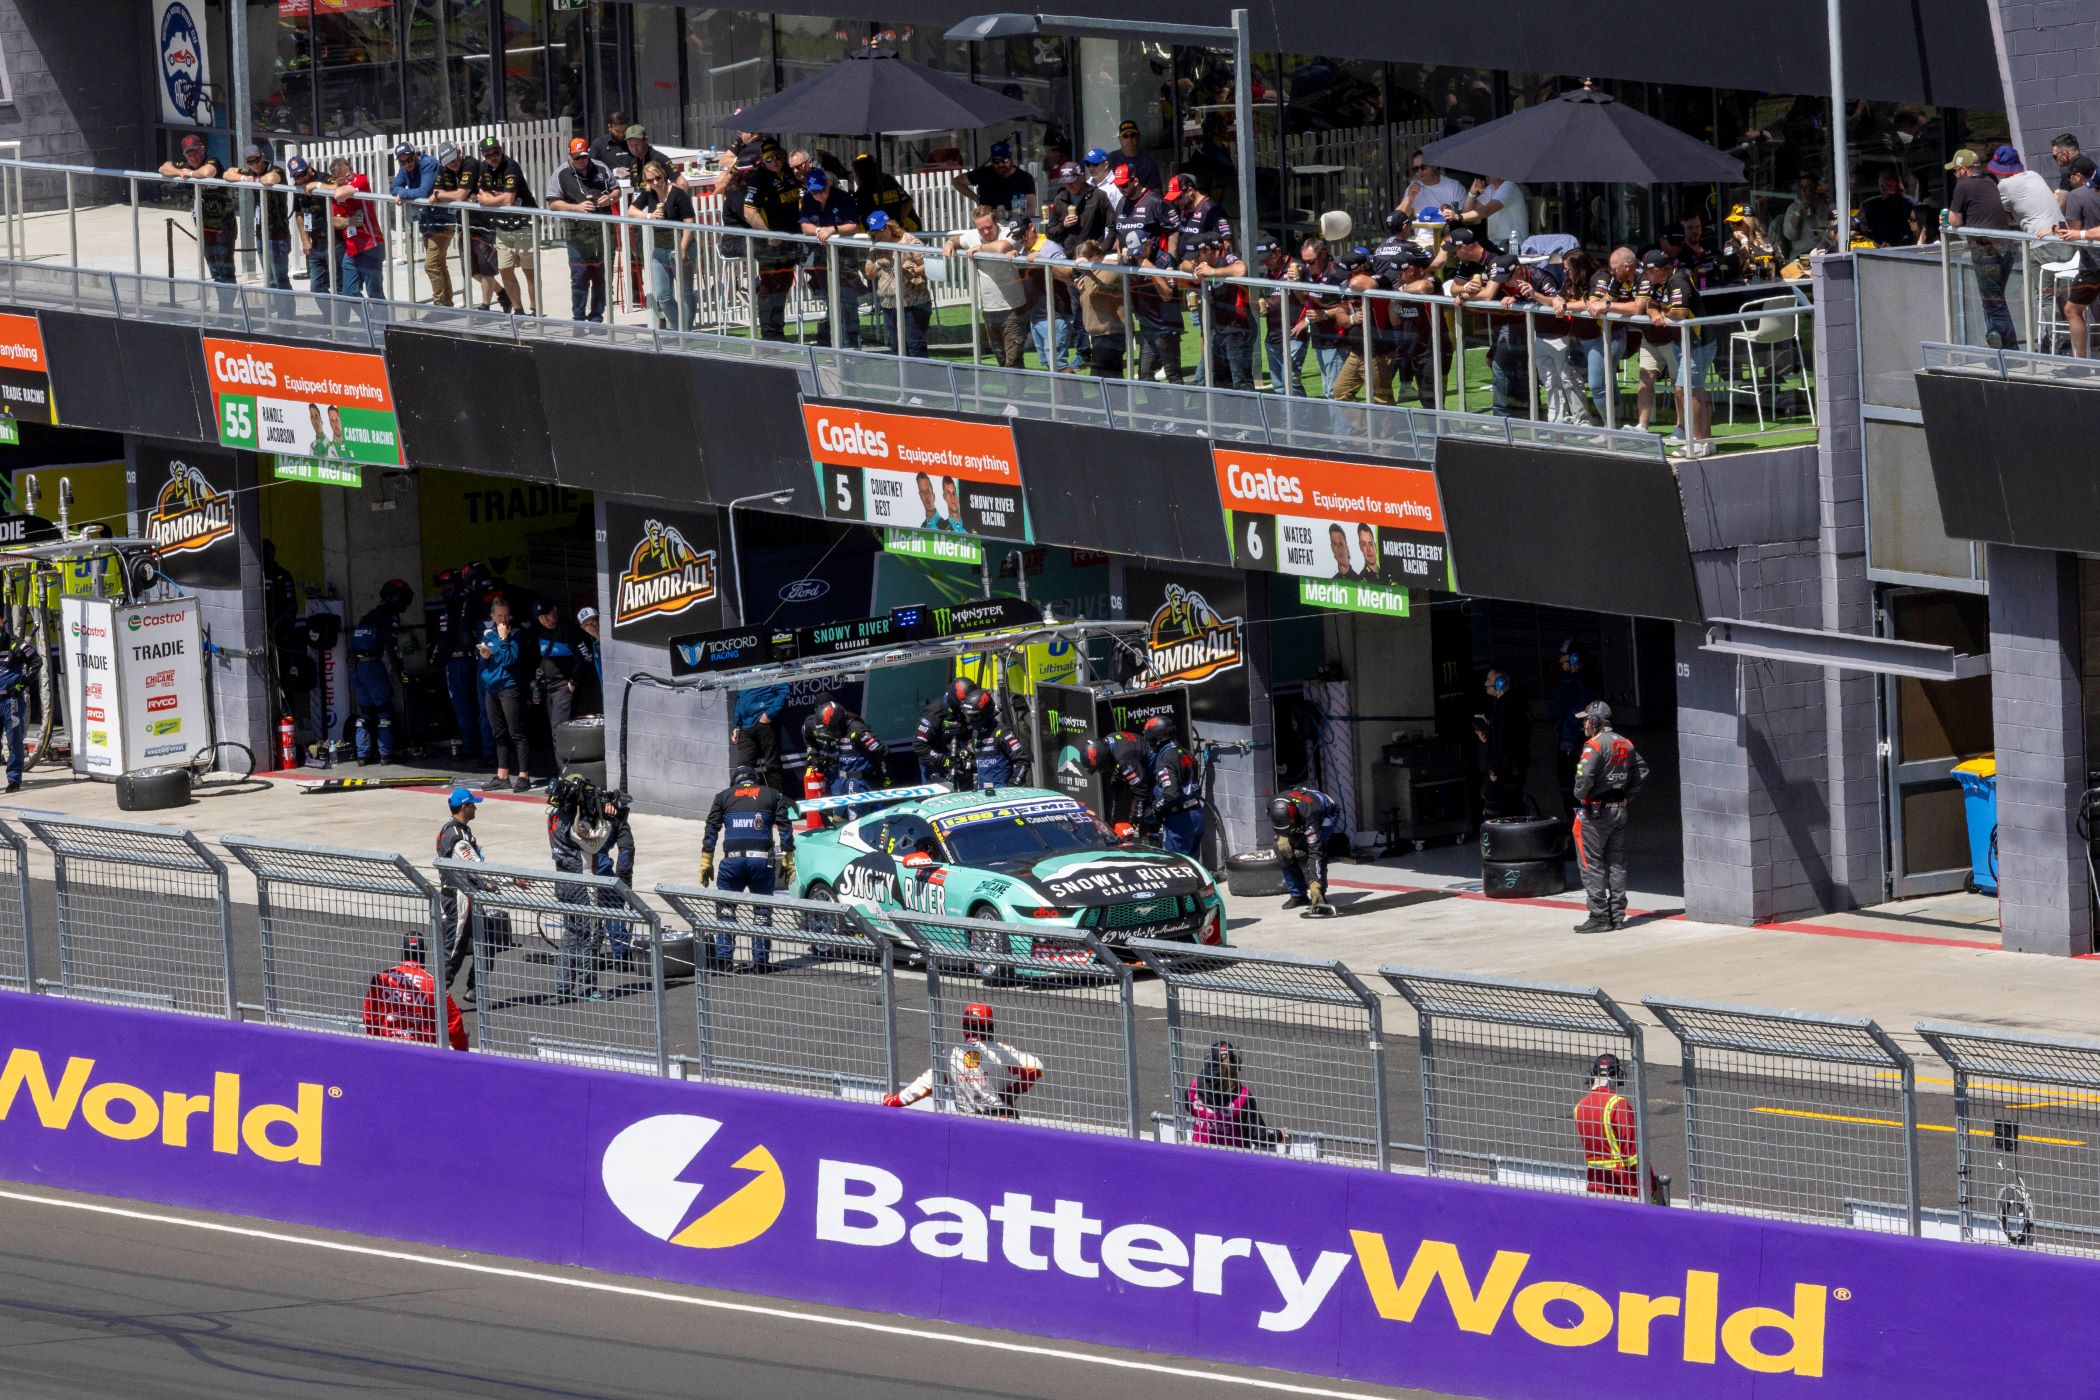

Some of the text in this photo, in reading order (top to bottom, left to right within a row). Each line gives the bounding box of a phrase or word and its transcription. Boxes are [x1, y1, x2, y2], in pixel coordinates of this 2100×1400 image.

[0, 343, 38, 363] anything
[215, 351, 276, 388] Coates
[2, 385, 45, 404] TRADIE RACING
[284, 375, 383, 402] Equipped for anything
[225, 402, 252, 439] 55
[262, 406, 284, 424] RANDLE
[266, 426, 296, 445] JACOBSON
[344, 426, 395, 446] CASTROL RACING
[817, 418, 889, 458] Coates
[278, 455, 357, 482] Merlin Merlin
[898, 444, 1010, 475] Equipped for anything
[126, 471, 137, 484] 08
[1227, 463, 1303, 504] Coates
[836, 473, 852, 512] 5
[870, 477, 903, 498] COURTNEY
[463, 485, 579, 523] TRADIE
[875, 499, 891, 517] BEST
[969, 494, 1015, 513] SNOWY RIVER
[1312, 491, 1432, 521] Equipped for anything
[981, 512, 1005, 527] RACING
[596, 529, 607, 542] 07
[888, 529, 976, 560] Merlin Merlin
[1246, 521, 1264, 561] 6
[1283, 525, 1312, 545] WATERS
[1287, 547, 1315, 566] MOFFAT
[1383, 540, 1443, 562] MONSTER ENERGY
[1402, 558, 1429, 576] RACING
[788, 583, 820, 600] Ford
[1305, 579, 1403, 611] Merlin Merlin
[1110, 595, 1123, 610] 06
[143, 610, 185, 627] Castrol
[952, 605, 1004, 623] MONSTER
[960, 617, 997, 629] ENERGY
[80, 624, 107, 638] Castrol
[814, 619, 890, 644] SNOWY RIVER
[132, 640, 185, 661] TRADIE
[835, 638, 870, 651] CARAVANS
[76, 652, 108, 671] TRADIE
[711, 649, 739, 662] RACING
[1677, 662, 1690, 677] 05
[148, 698, 176, 708] RYCO
[1127, 704, 1175, 720] MONSTER
[87, 709, 104, 719] RYCO
[1058, 715, 1088, 729] MONSTER
[829, 785, 936, 805] sutton
[732, 818, 753, 828] NAVY
[945, 811, 994, 827] 1300
[998, 809, 1011, 818] 4
[1014, 818, 1025, 826] 5
[1026, 813, 1069, 824] Courtney
[887, 837, 896, 854] 5
[840, 864, 946, 916] SNOWY RIVER
[1049, 866, 1199, 898] SNOWY RIVER
[1101, 881, 1168, 896] CARAVANS
[0, 1047, 324, 1167] World
